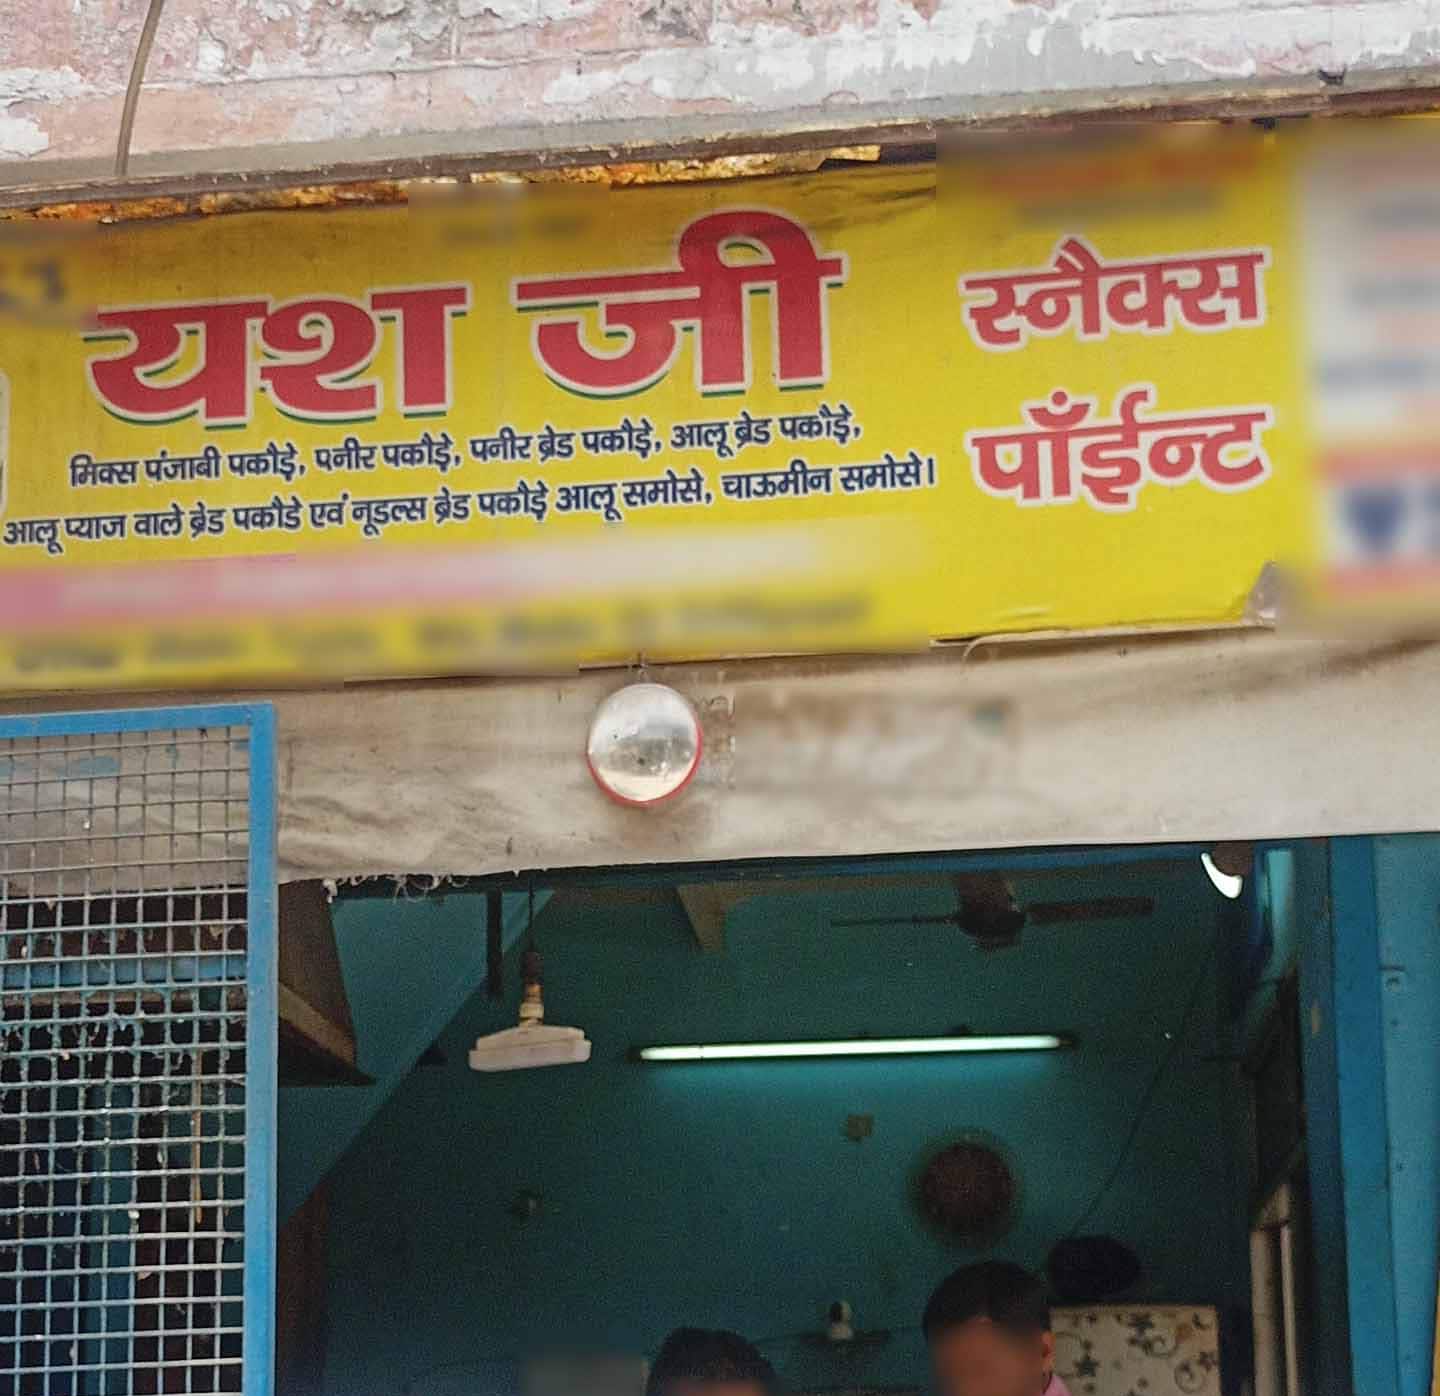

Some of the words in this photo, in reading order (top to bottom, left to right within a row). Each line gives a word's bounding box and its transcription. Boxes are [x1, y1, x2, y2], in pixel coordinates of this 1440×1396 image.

[86, 284, 469, 428] यश
[515, 208, 848, 400] जी
[962, 237, 1267, 347] स्नैक्स
[70, 454, 138, 486] मिक्स
[145, 450, 221, 480] पंजाबी
[315, 437, 376, 470] पनीर
[470, 427, 533, 461] पनीर
[538, 425, 575, 461] ब्रेड
[670, 420, 732, 457] आलू
[735, 412, 772, 448] ब्रेड
[3, 518, 63, 553] आलू
[65, 515, 126, 539] प्याज
[134, 502, 184, 536] वाले
[189, 502, 226, 538] ब्रेड
[310, 493, 350, 527] एवं
[352, 497, 427, 535] नूडल्स
[434, 487, 472, 524] ब्रेड
[555, 482, 622, 520] आलू
[622, 468, 713, 507] समोसे,
[722, 459, 833, 500] चाऊमीन
